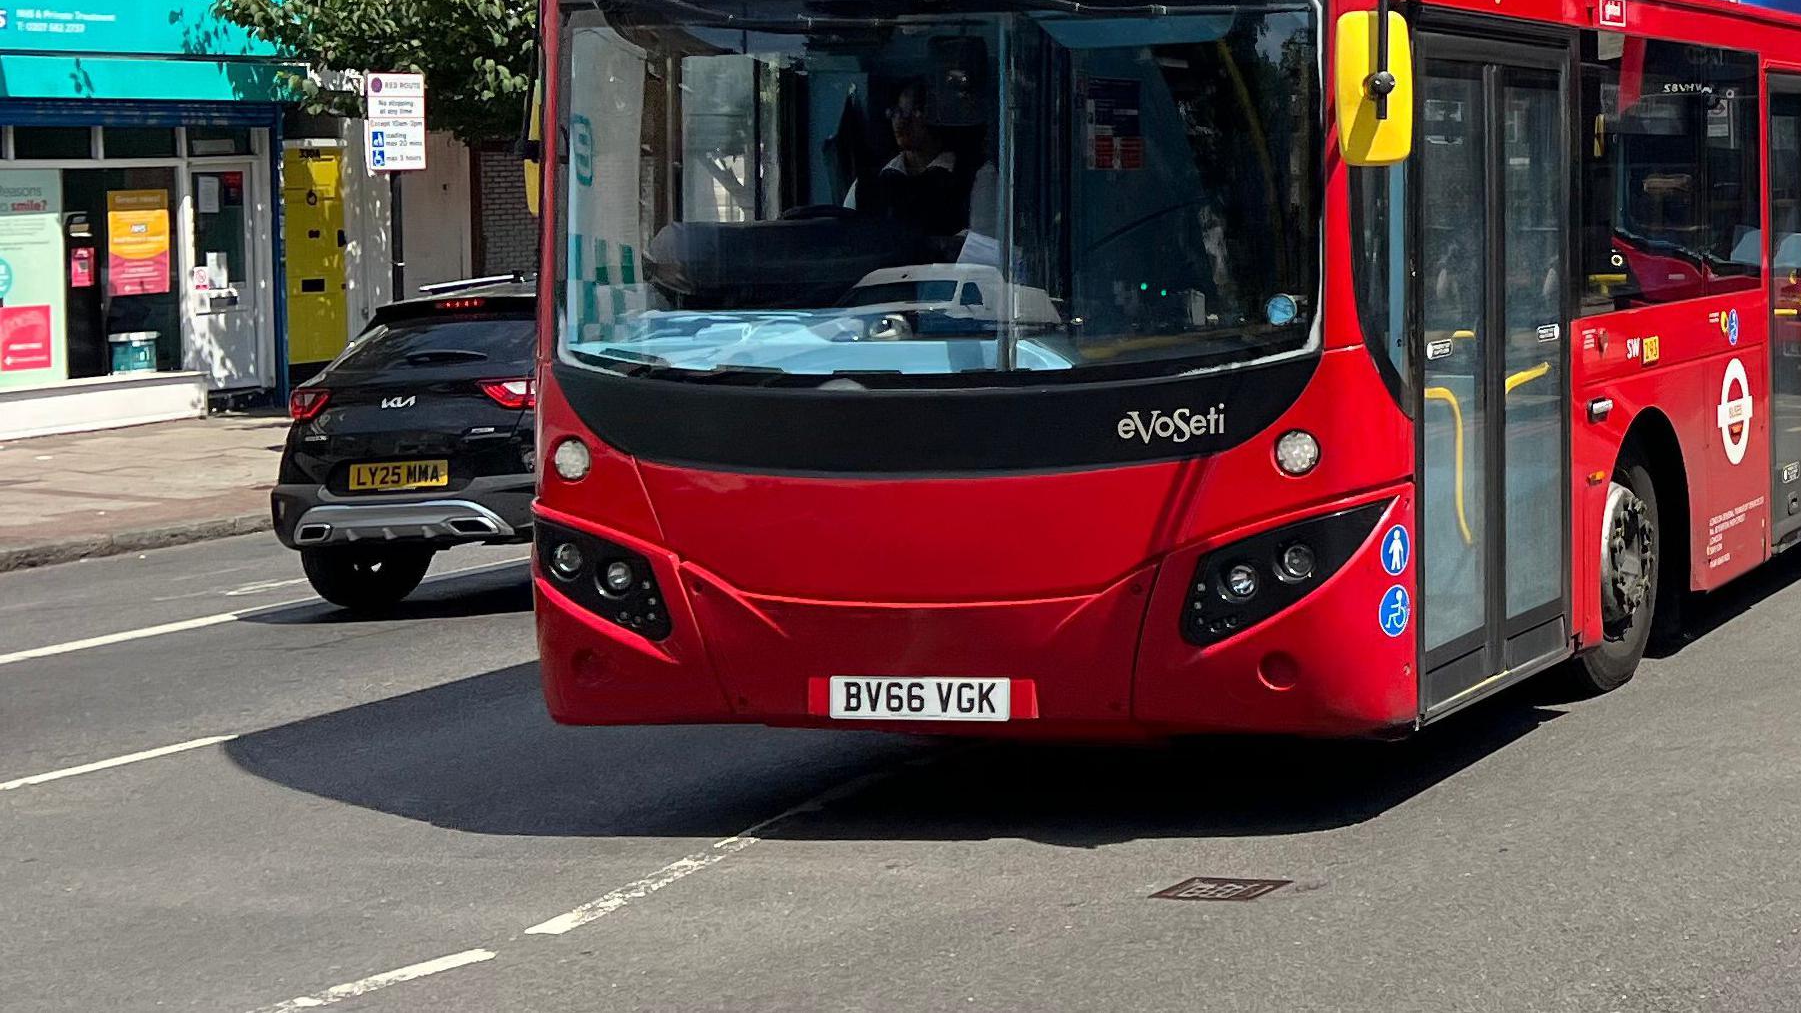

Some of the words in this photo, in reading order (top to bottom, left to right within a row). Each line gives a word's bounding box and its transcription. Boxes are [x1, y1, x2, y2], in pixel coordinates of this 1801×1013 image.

[1626, 338, 1641, 360] SW
[356, 466, 401, 486] LY25
[843, 681, 925, 713] BV66
[935, 682, 997, 714] VGK
